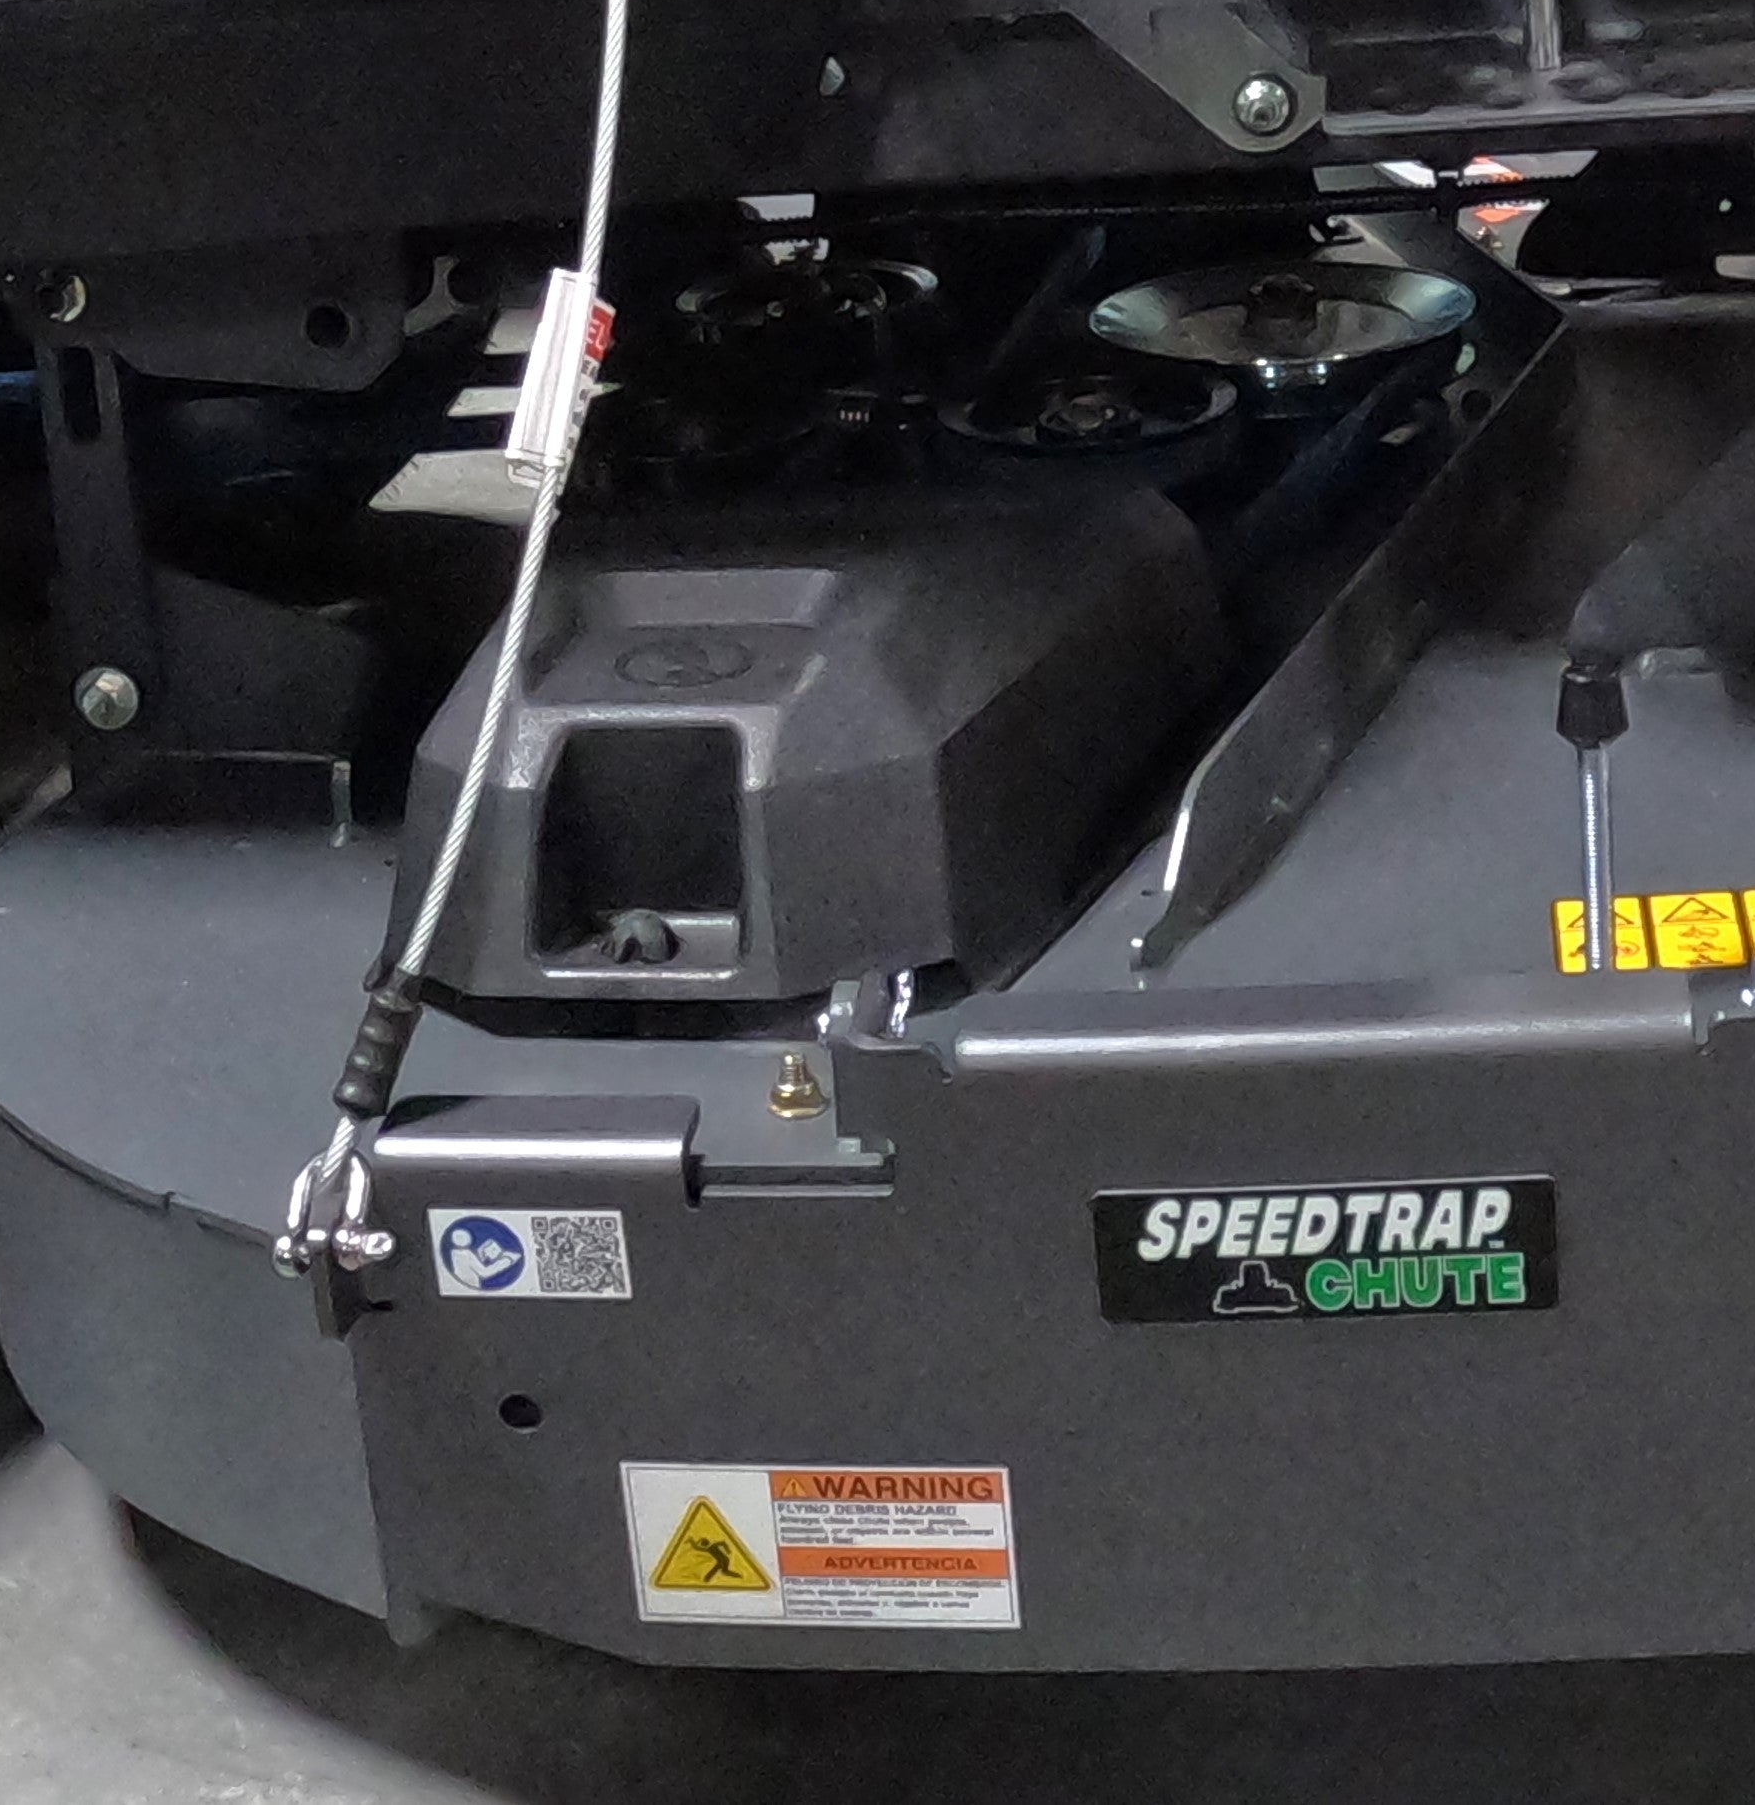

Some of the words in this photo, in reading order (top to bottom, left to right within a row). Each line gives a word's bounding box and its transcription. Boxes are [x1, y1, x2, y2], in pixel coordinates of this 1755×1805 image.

[1137, 1188, 1512, 1262] SPEEDTRAP
[1305, 1252, 1526, 1311] CHUTE
[812, 1475, 994, 1500] WARNING
[777, 1503, 830, 1515] FLYING
[834, 1504, 890, 1516] DEBRIS
[895, 1504, 957, 1516] HAZARD
[824, 1556, 978, 1571] ADVERTENCIA
